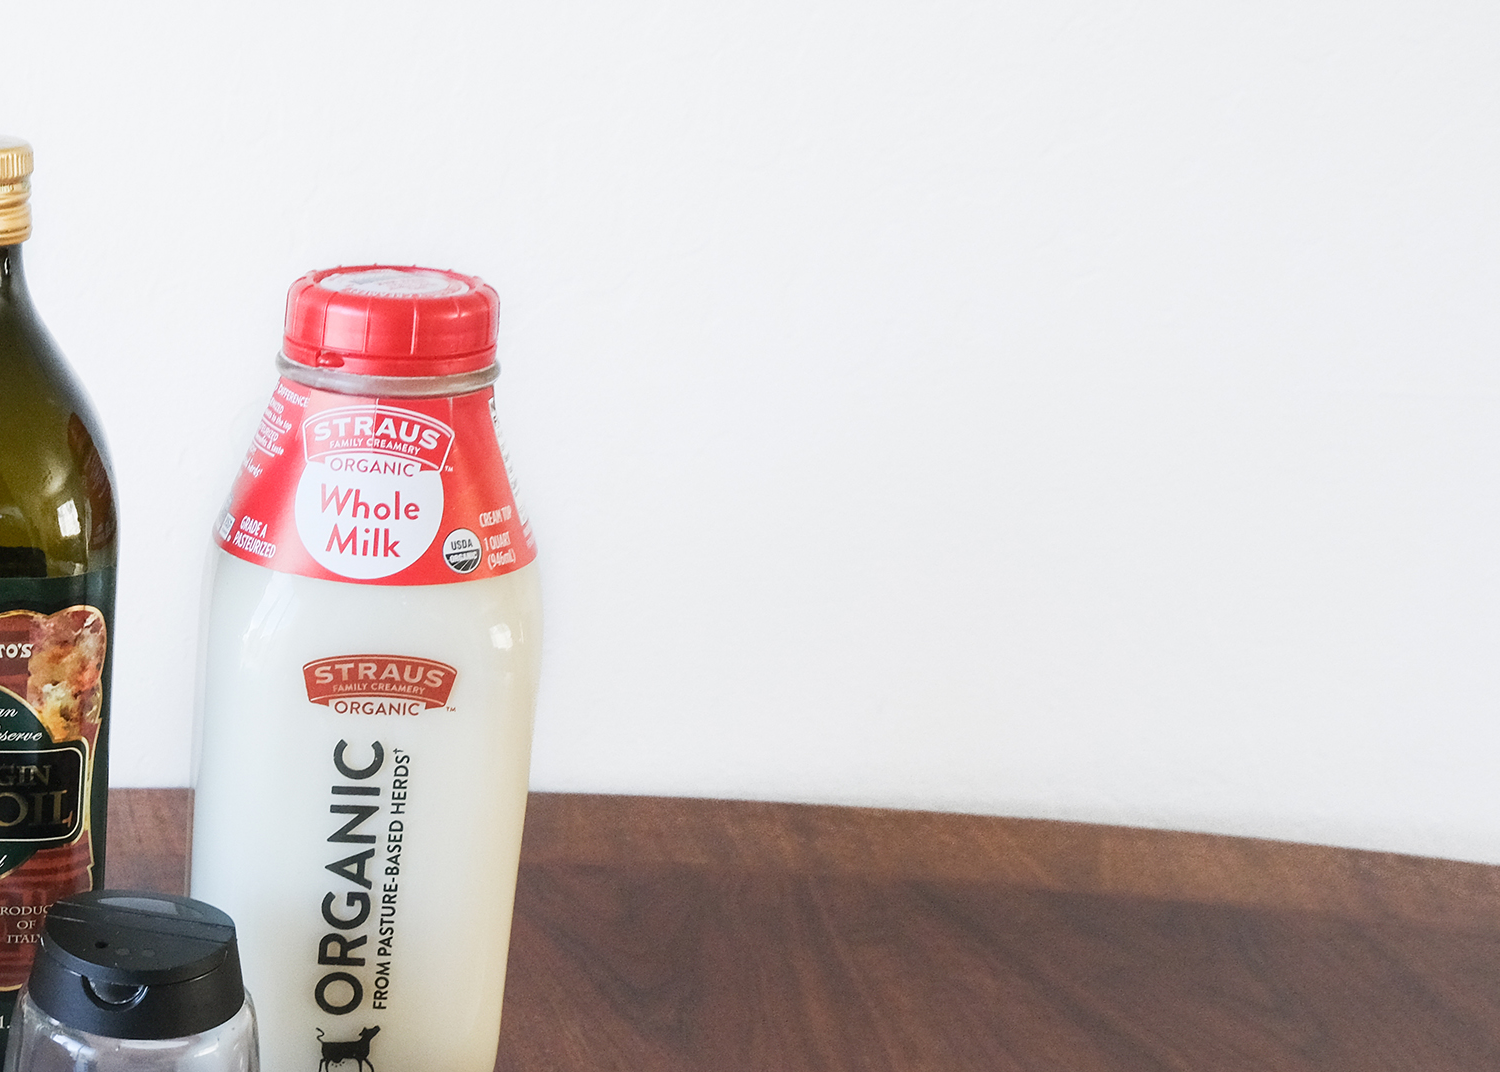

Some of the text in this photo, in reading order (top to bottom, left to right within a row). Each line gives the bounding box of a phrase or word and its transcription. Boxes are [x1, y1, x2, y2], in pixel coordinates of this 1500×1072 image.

[314, 416, 441, 450] STRAUS
[330, 438, 421, 455] FAMILY CREAMERY
[330, 458, 414, 477] ORGANIC
[321, 483, 420, 520] Whole
[240, 516, 262, 535] GRADE
[260, 524, 268, 538] A
[233, 531, 276, 558] PASTEURIZED
[326, 523, 401, 558] Milk
[450, 539, 473, 550] USDA
[484, 537, 489, 552] 1
[490, 532, 511, 550] QUART
[314, 663, 445, 688] STRAUS
[333, 683, 426, 694] FAMILY CREAMERY
[334, 700, 420, 716] ORGANIC
[314, 739, 384, 1015] ORGANIC
[378, 820, 404, 956] PASTURE-BASED
[16, 920, 36, 930] OF
[372, 961, 390, 1010] FROM
